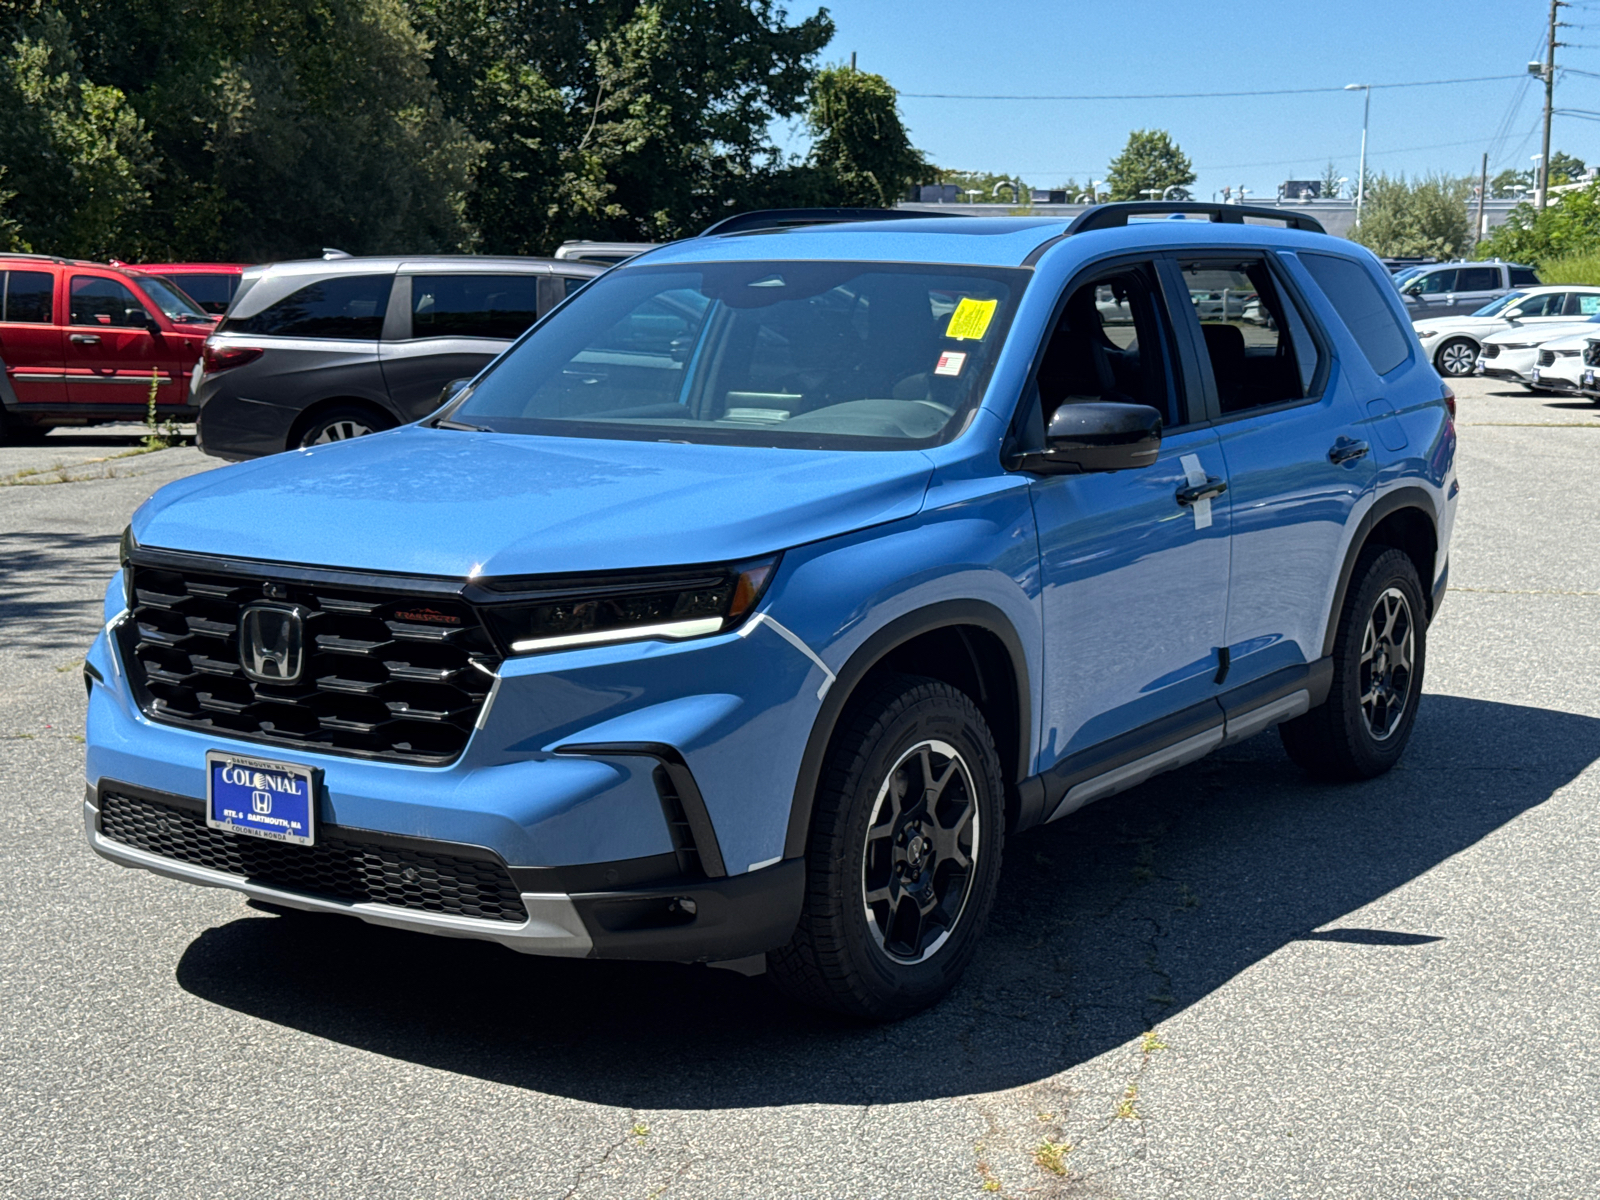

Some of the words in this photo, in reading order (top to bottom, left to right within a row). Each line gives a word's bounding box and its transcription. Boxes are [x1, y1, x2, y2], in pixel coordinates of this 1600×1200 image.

[222, 767, 301, 795] COLONIAL
[223, 809, 238, 818] RTE.
[238, 811, 243, 819] 6
[247, 813, 290, 828] DARTMOUTH,
[290, 820, 301, 829] MA
[231, 826, 262, 837] COLONIAL
[263, 831, 287, 840] HONDA
